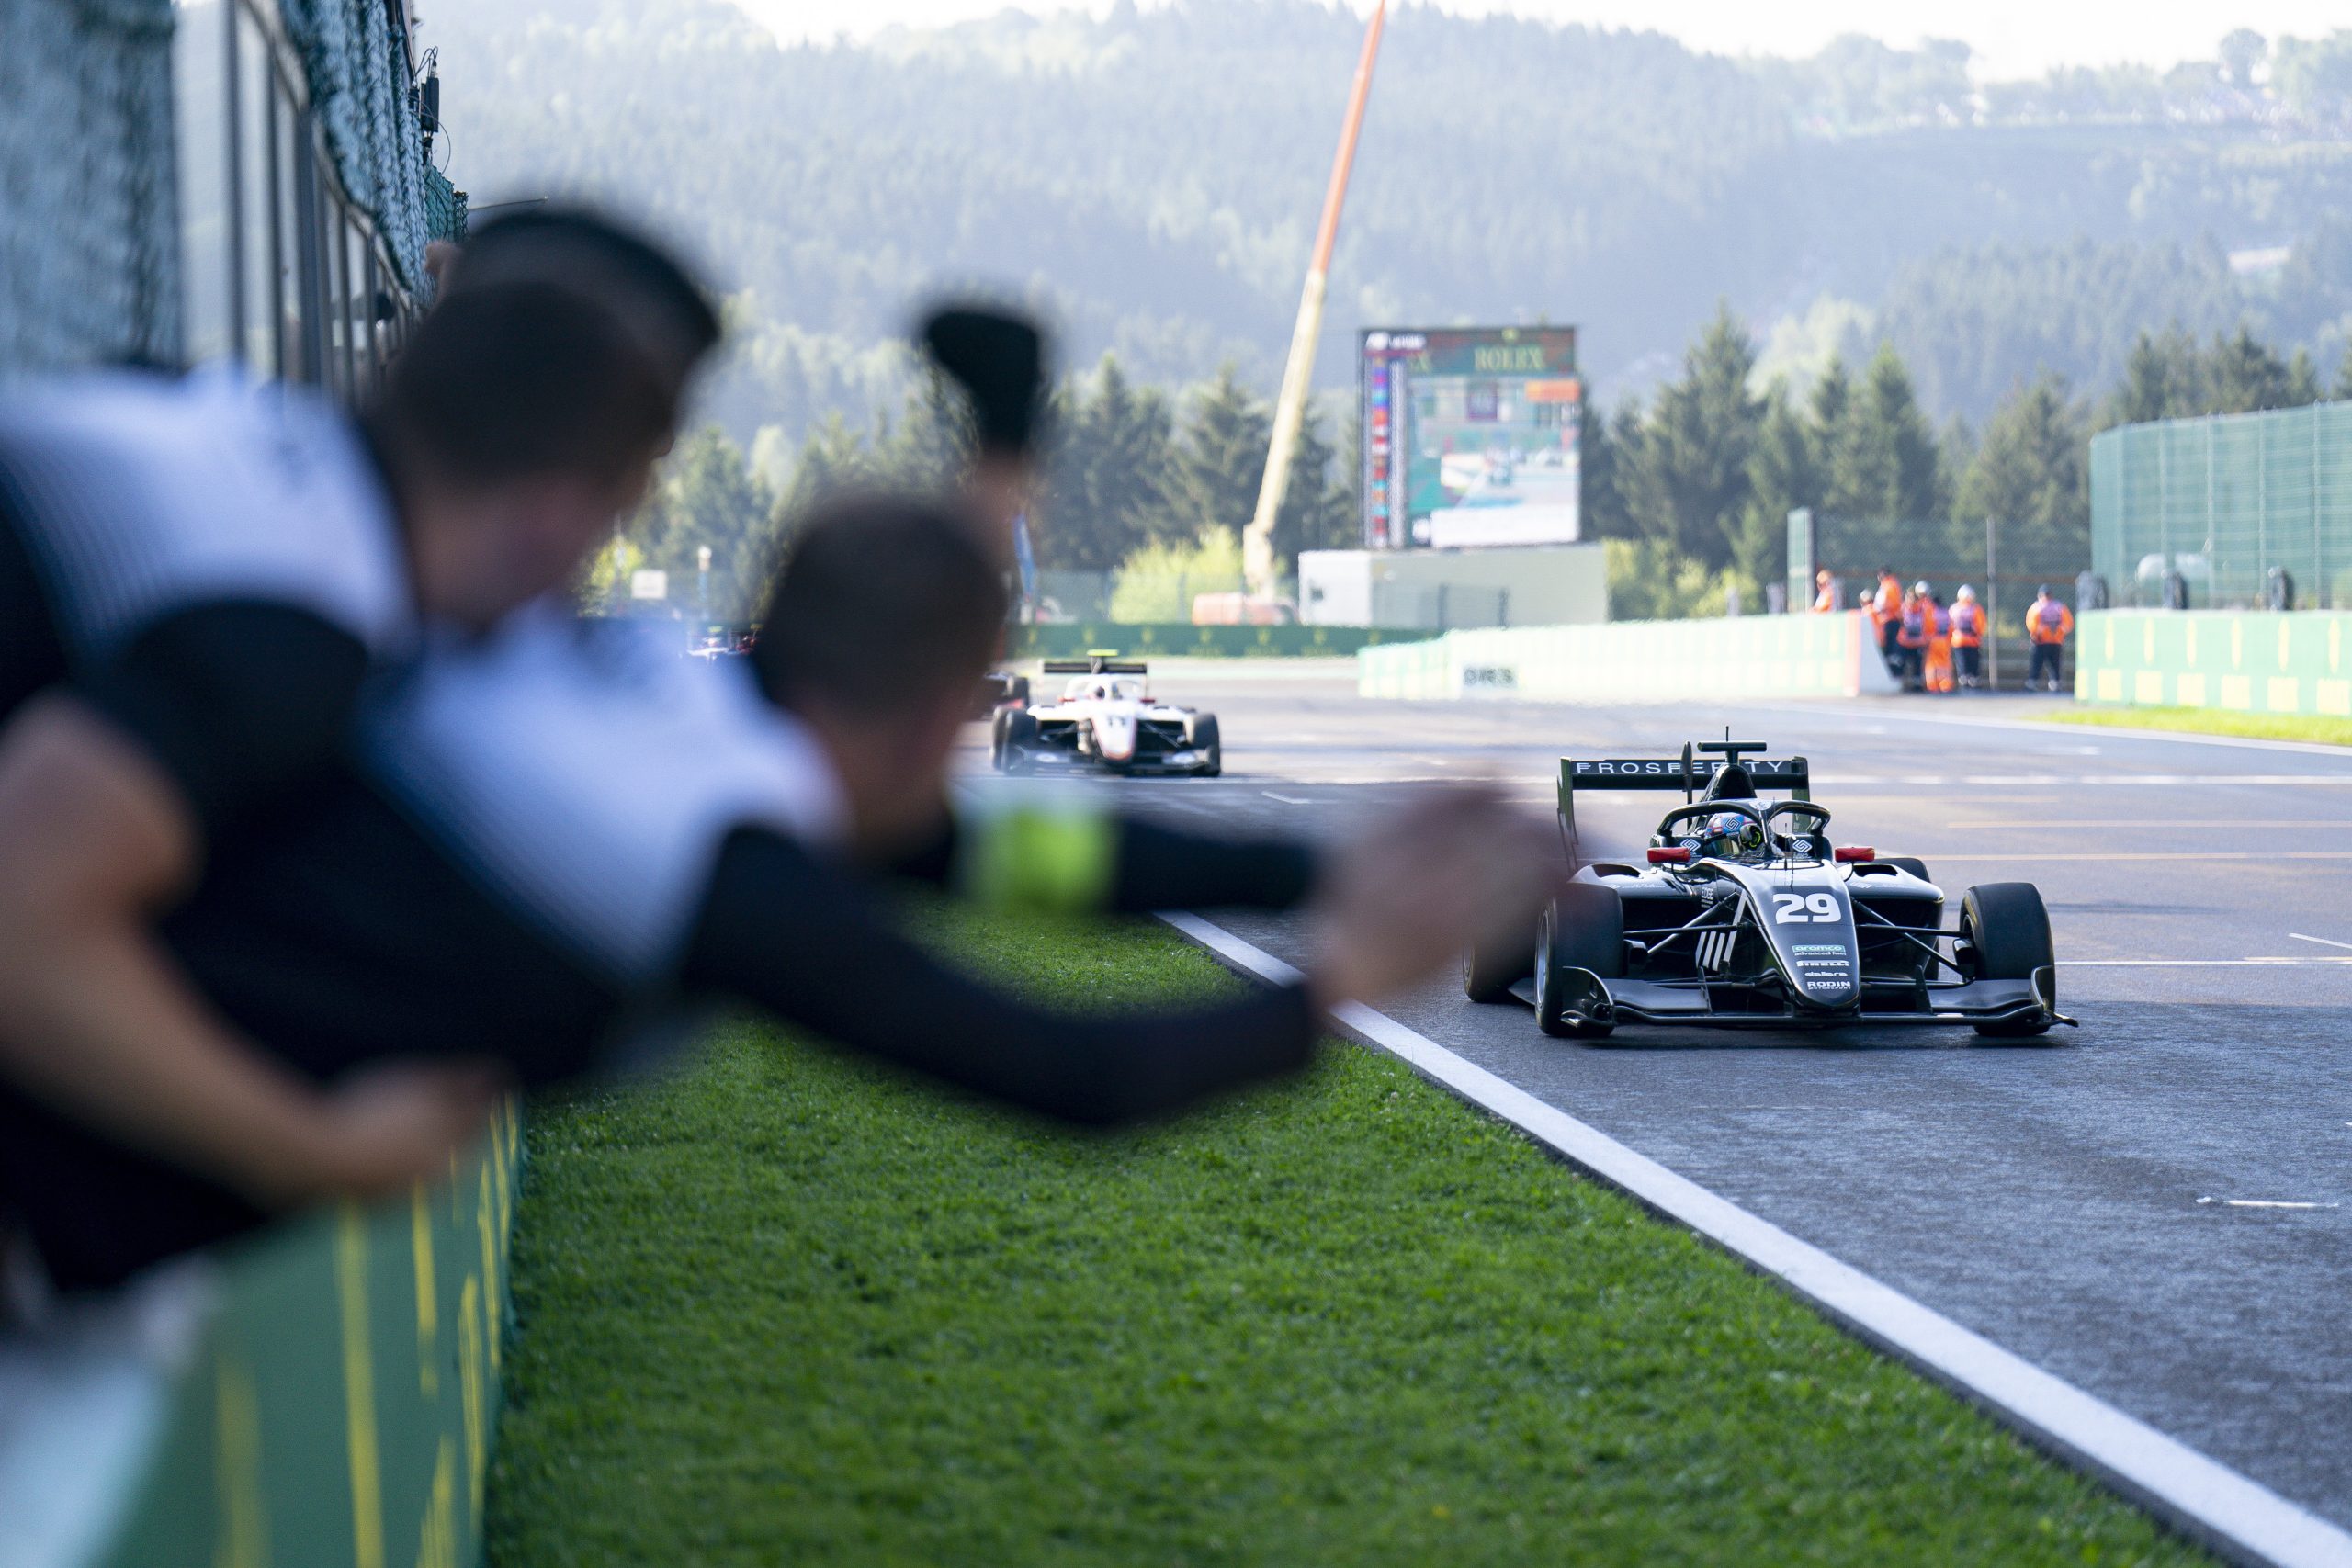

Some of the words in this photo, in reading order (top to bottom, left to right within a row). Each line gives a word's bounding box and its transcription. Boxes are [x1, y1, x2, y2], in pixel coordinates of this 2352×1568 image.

[1474, 347, 1543, 369] ROLEX
[1576, 761, 1783, 773] PROSPETY
[1773, 893, 1841, 924] 29
